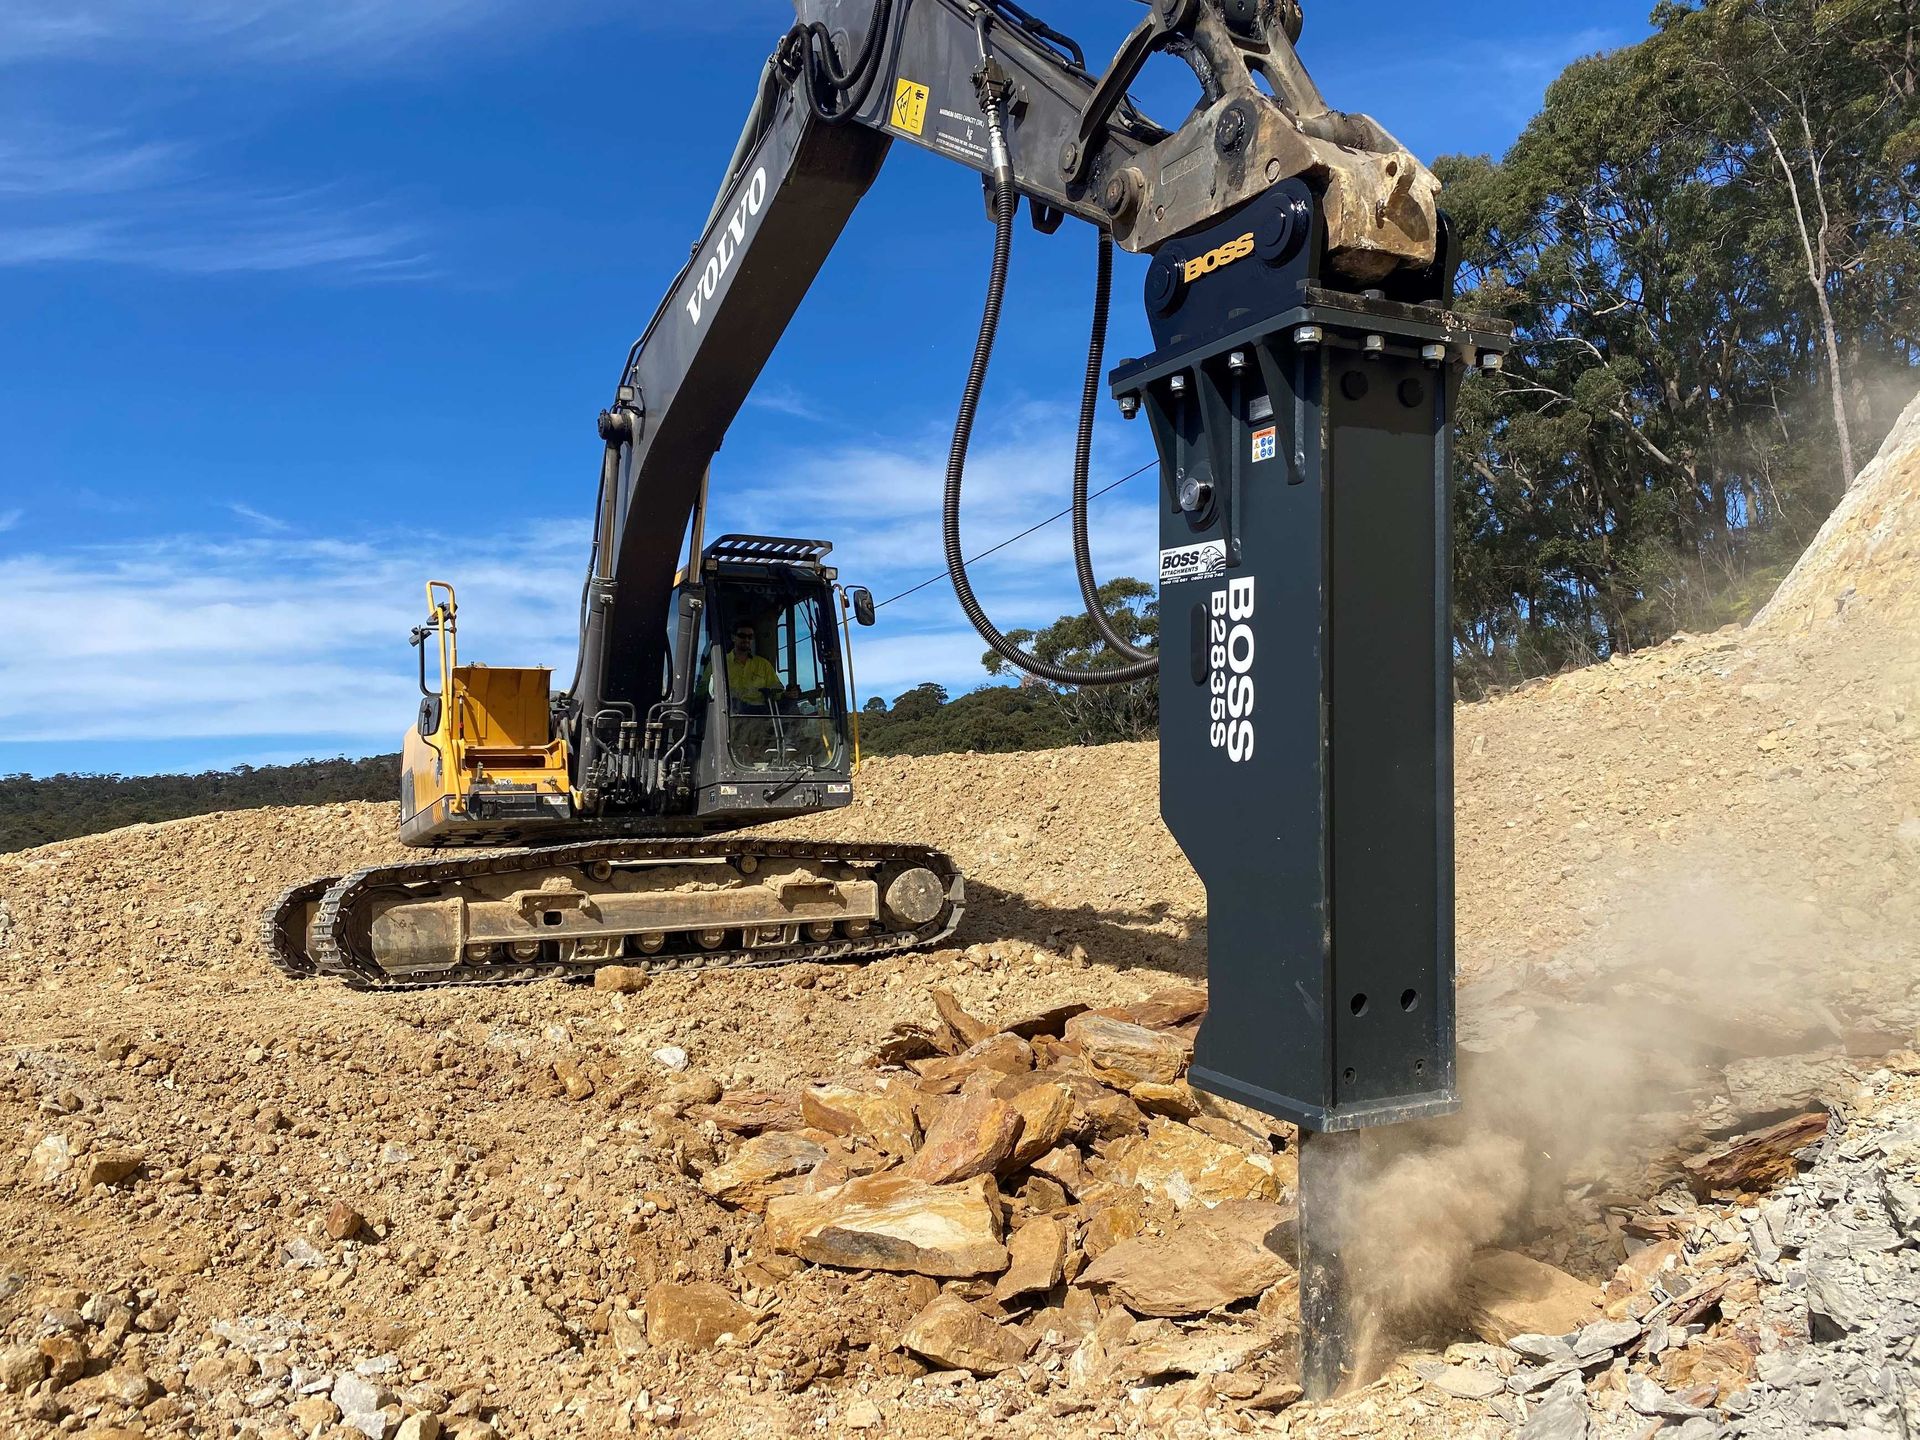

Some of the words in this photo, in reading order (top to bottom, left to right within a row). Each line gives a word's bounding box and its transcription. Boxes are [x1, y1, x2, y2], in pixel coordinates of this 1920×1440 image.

[686, 166, 767, 326] VOLVO
[1184, 232, 1255, 283] BOSS
[1161, 566, 1199, 577] ATTACHMENTS
[1162, 551, 1200, 569] BOSS
[1210, 590, 1227, 748] B2835S
[1227, 576, 1255, 763] BOSS
